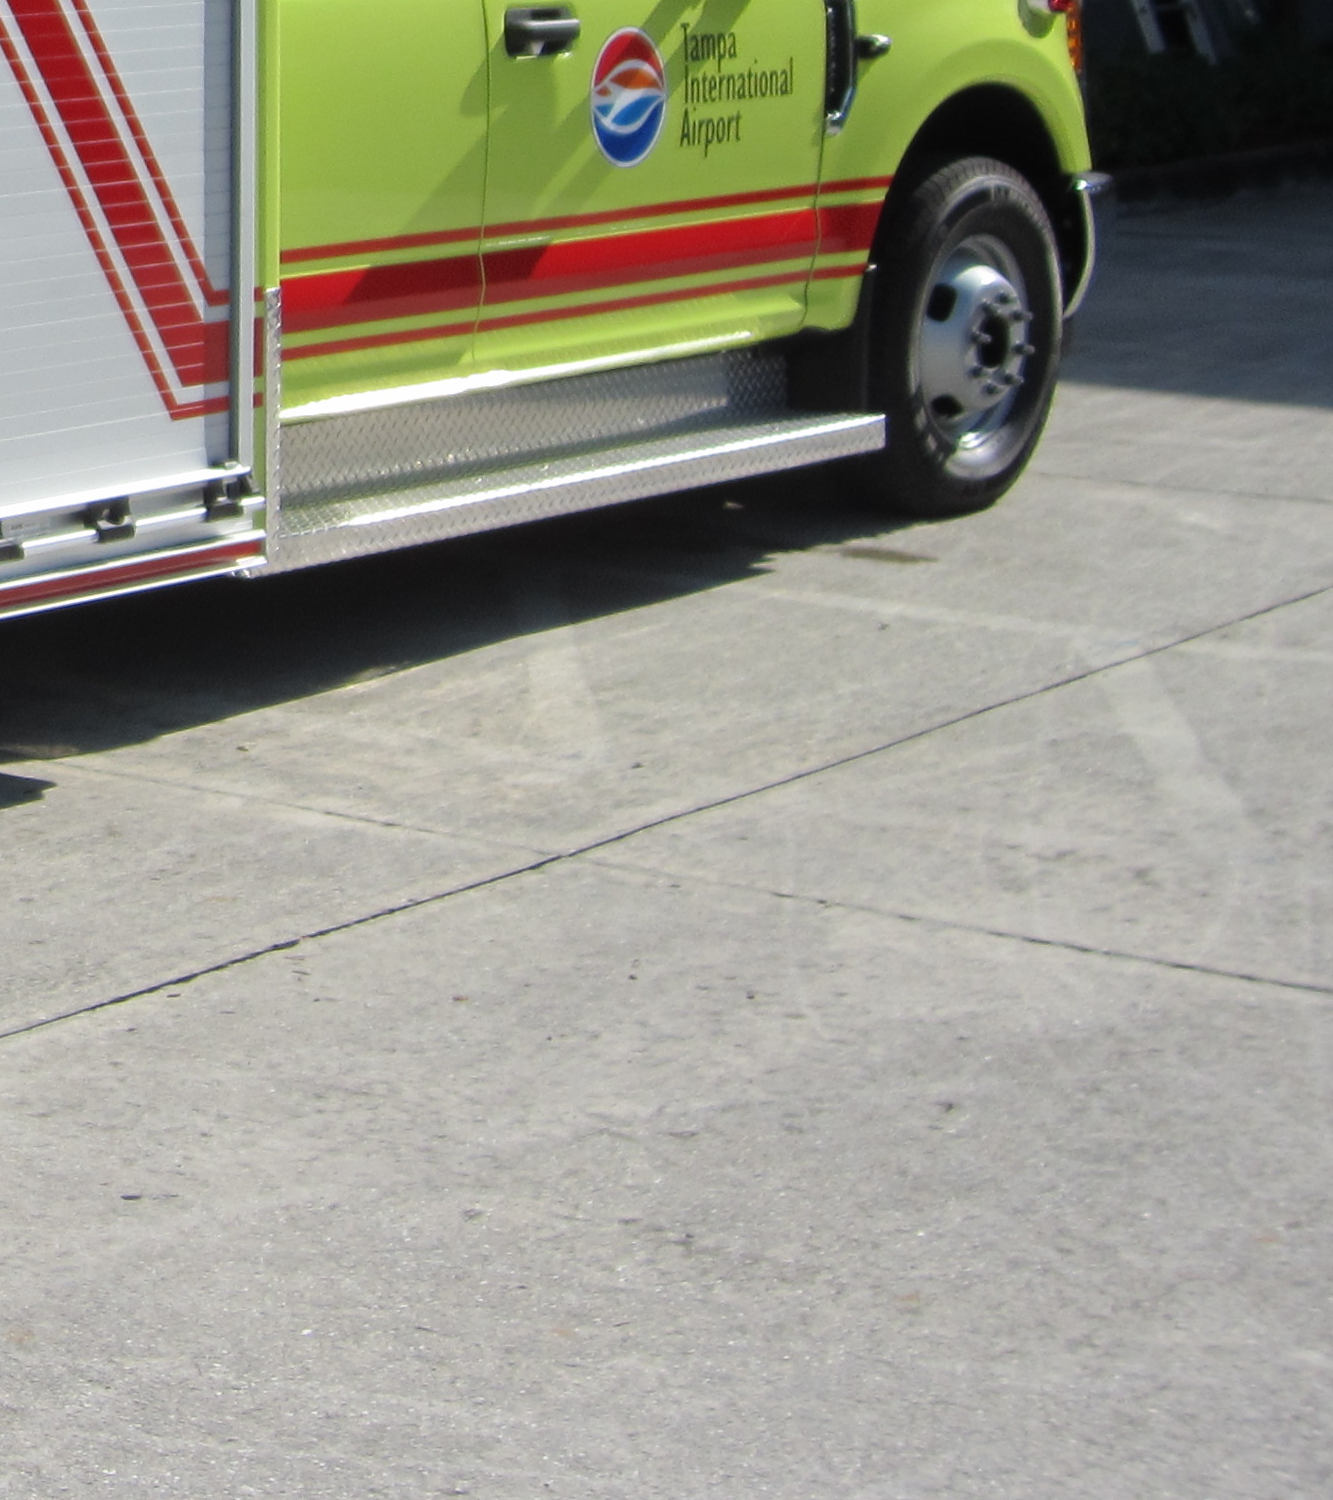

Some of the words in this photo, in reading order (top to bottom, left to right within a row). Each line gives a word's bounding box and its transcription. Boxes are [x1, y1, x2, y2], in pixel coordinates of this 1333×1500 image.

[680, 22, 737, 73] Tampa
[684, 56, 794, 104] International
[679, 106, 741, 157] Airport
